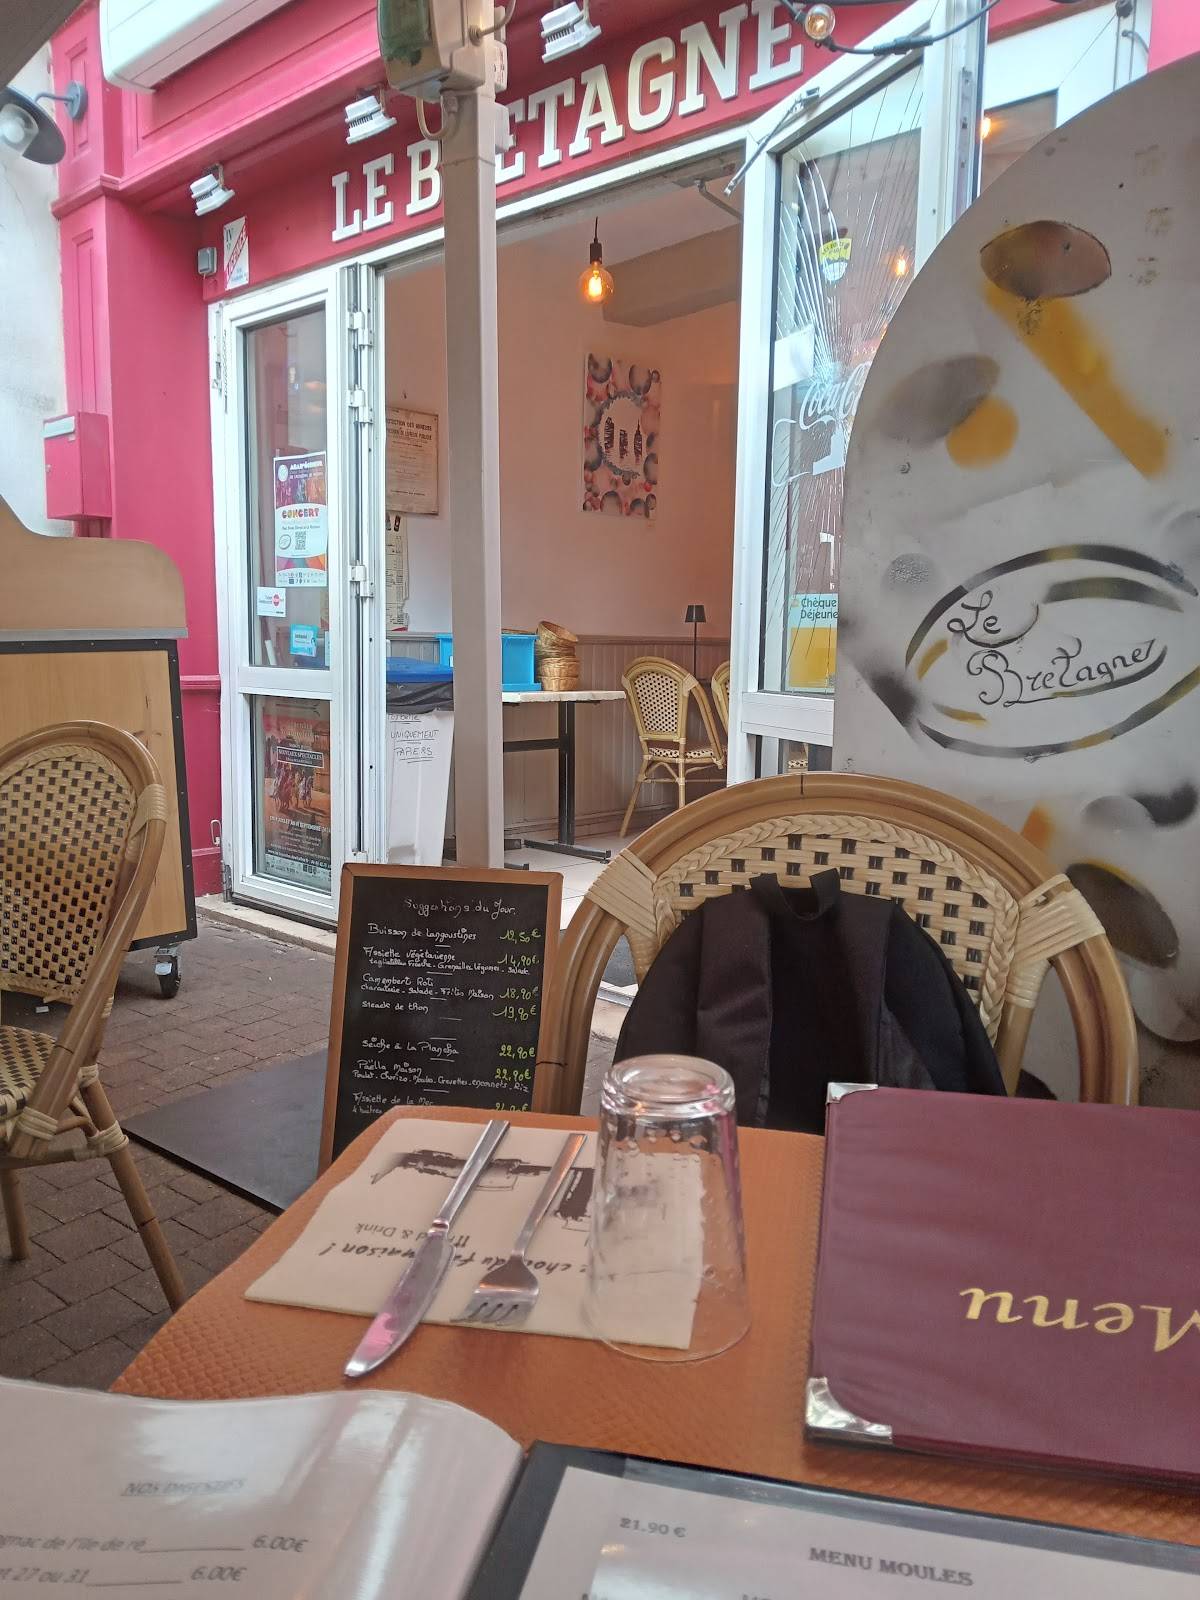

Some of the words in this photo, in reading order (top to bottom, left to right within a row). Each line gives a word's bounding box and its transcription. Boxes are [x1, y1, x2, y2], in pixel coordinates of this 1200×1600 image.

[331, 152, 395, 242] LE
[405, 0, 804, 217] BETAGNE
[281, 508, 320, 519] CONCERT
[801, 597, 837, 609] Chèque
[800, 609, 839, 621] Déjeune
[947, 590, 1038, 648] Le
[966, 637, 1158, 707] Bretagne
[411, 928, 422, 937] de
[499, 1044, 536, 1059] 22,90€
[494, 1068, 532, 1082] 22,90€
[355, 1222, 397, 1238] Drink
[959, 1287, 1200, 1353] Menu
[619, 1517, 669, 1537] 21.90
[673, 1526, 688, 1539] €
[252, 1535, 308, 1553] 6.00€
[190, 1565, 247, 1582] 6.00€
[808, 1546, 872, 1571] MENU
[878, 1559, 974, 1587] MOULES
